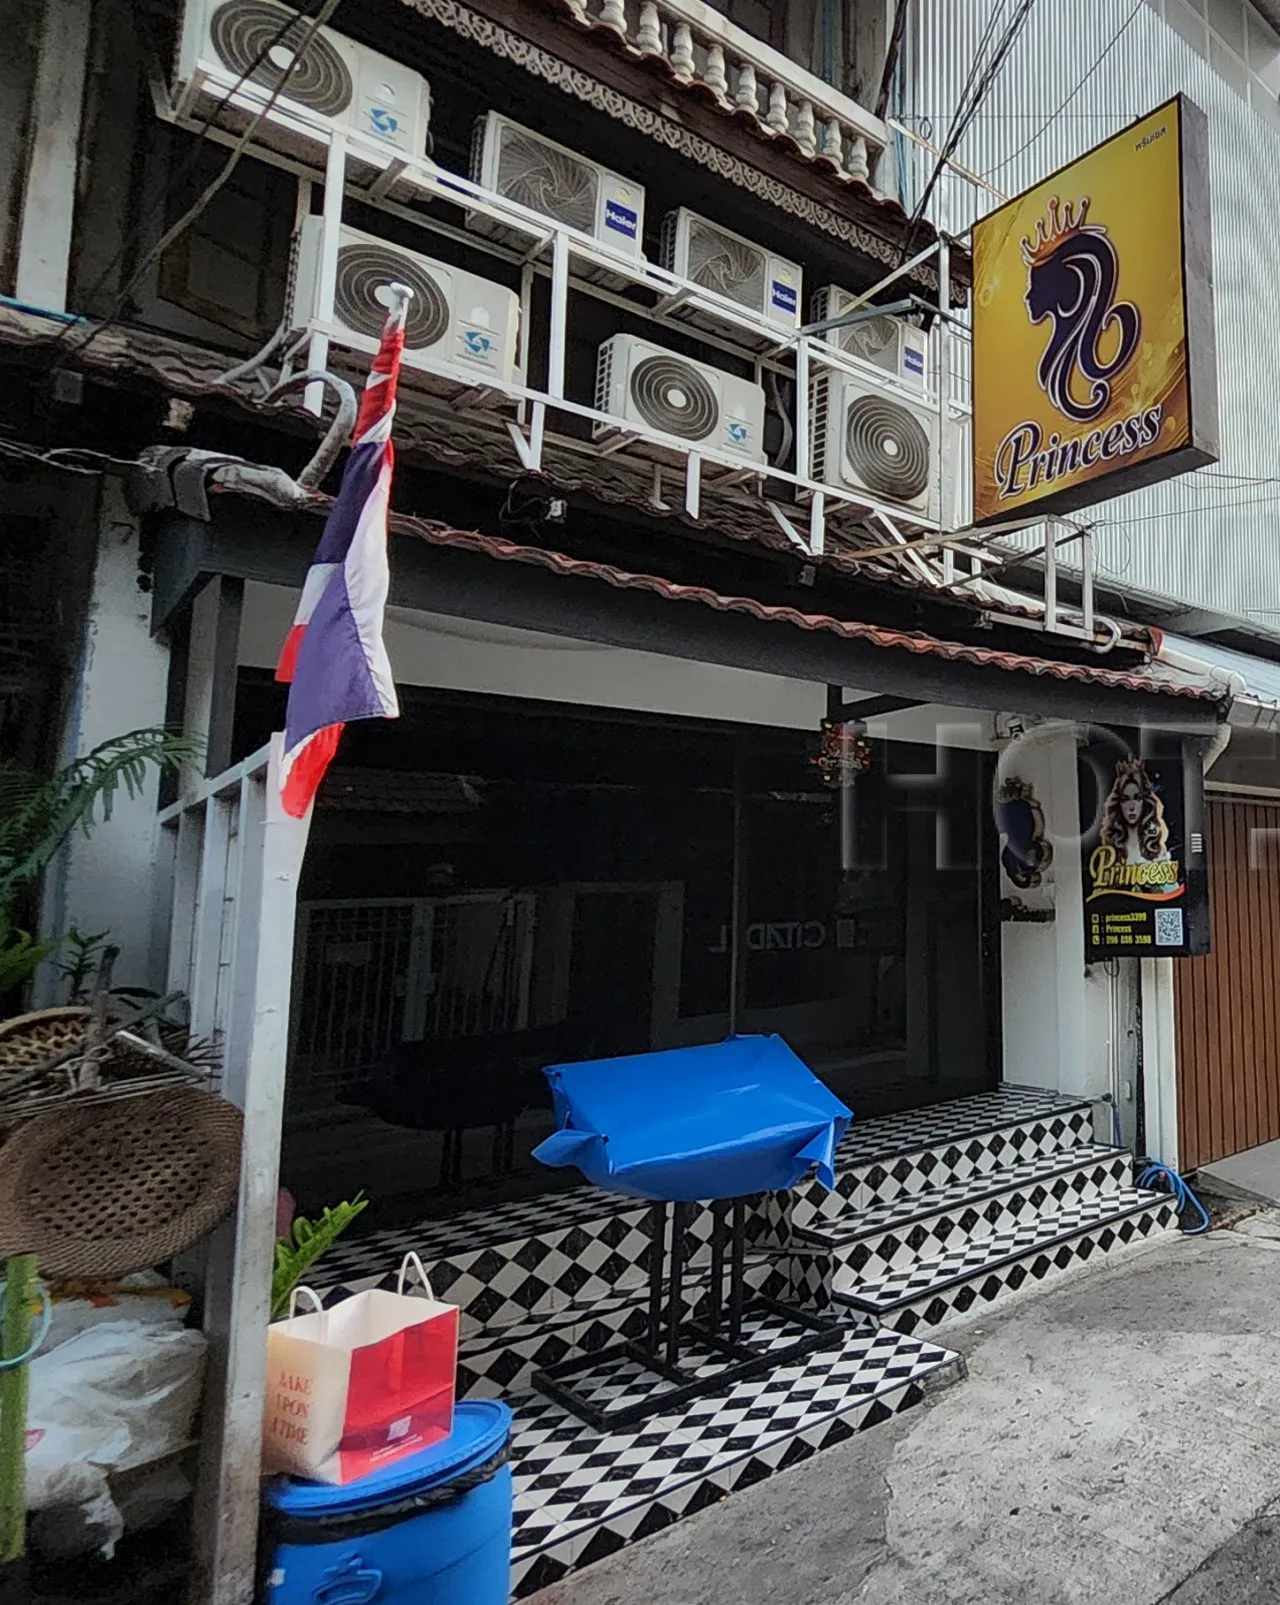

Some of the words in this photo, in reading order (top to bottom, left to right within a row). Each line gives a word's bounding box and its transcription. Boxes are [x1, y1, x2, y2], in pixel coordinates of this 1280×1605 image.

[606, 209, 636, 230] Haier
[772, 288, 796, 306] Haier
[995, 404, 1163, 500] Princess
[1089, 845, 1179, 888] Princess
[1106, 925, 1132, 933] Princess
